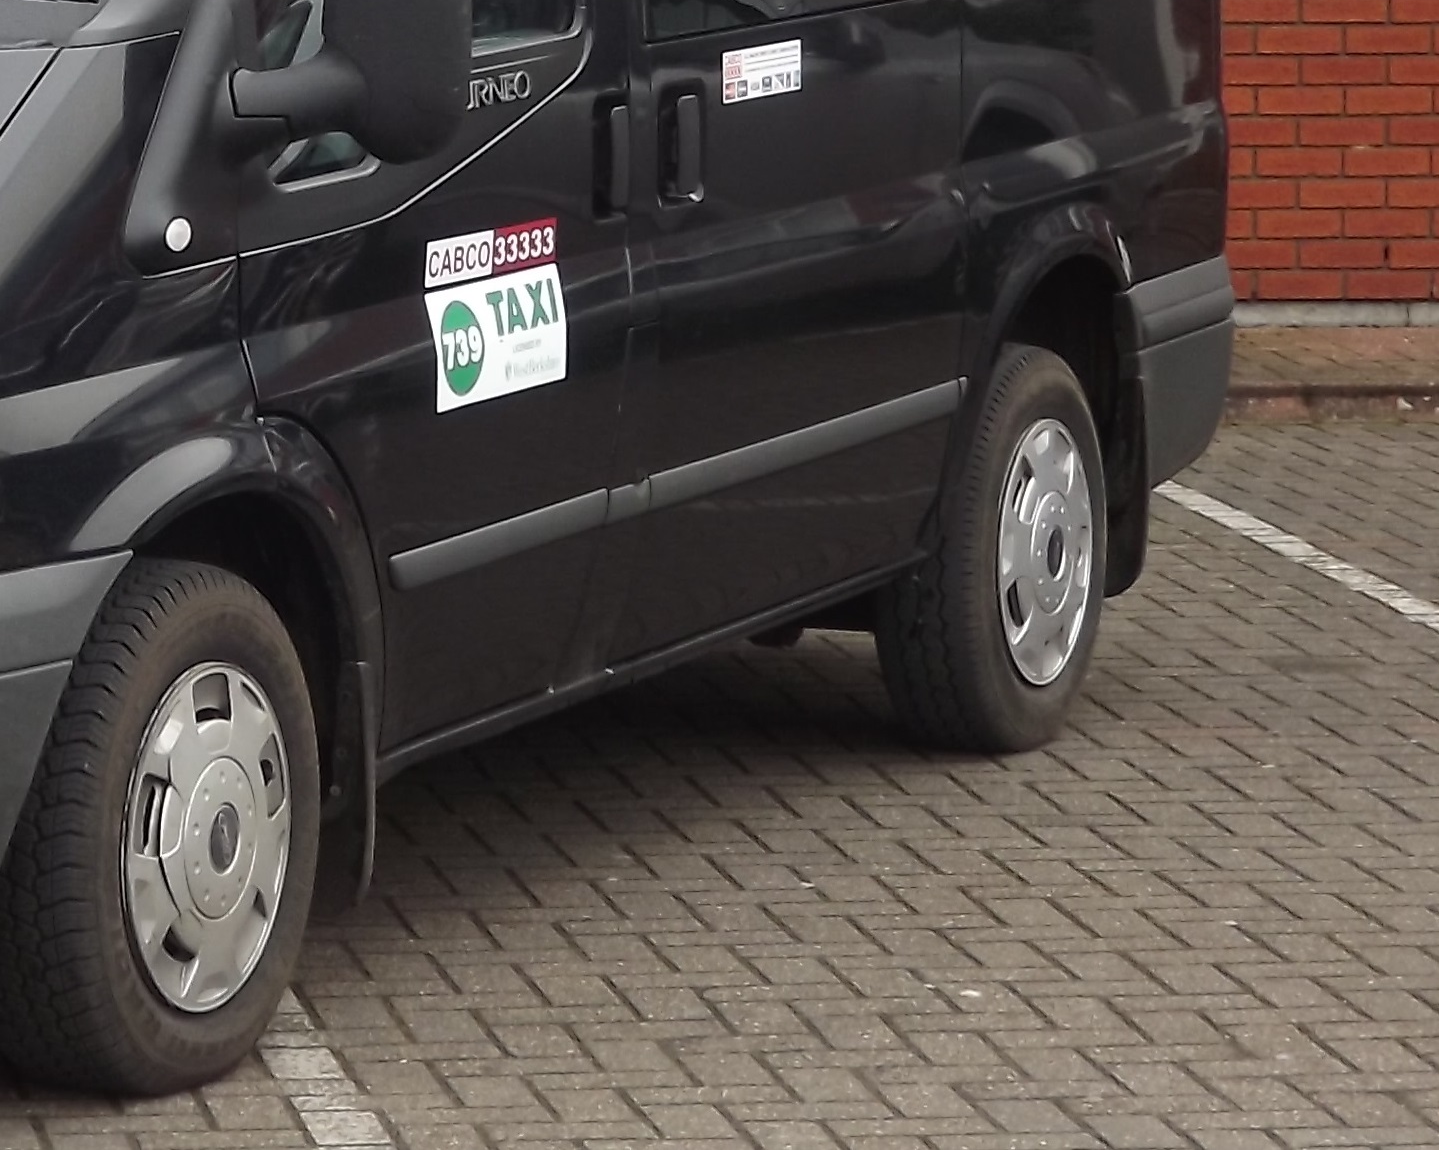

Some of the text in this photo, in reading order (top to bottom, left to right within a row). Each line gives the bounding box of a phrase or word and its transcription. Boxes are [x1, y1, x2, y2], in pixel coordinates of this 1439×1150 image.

[428, 226, 554, 278] CABCO 33333
[485, 278, 559, 337] TAXI
[441, 325, 484, 371] 739
